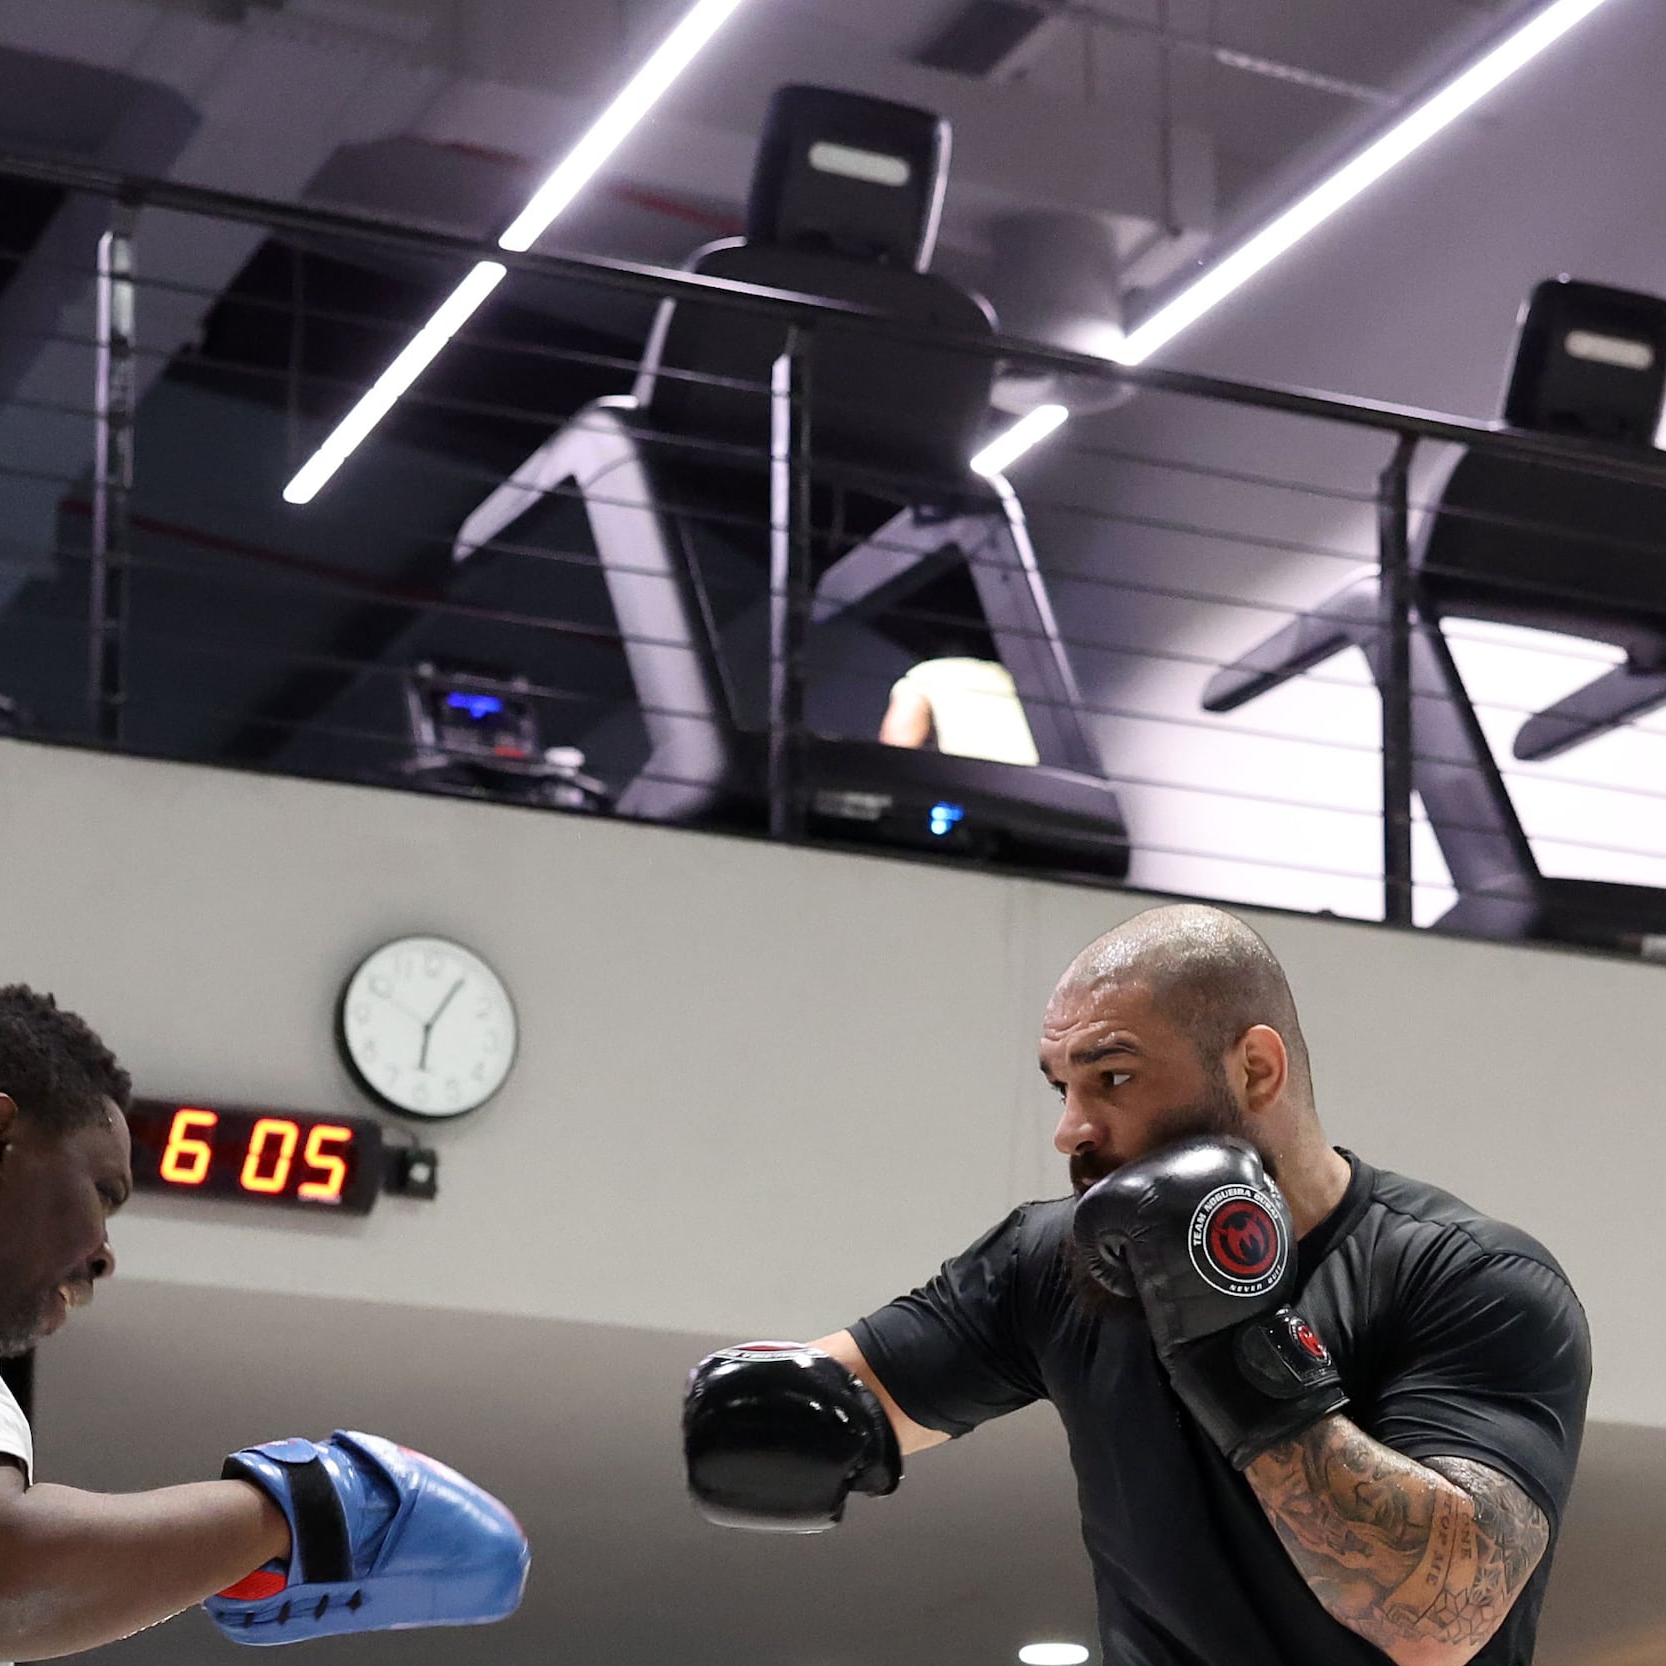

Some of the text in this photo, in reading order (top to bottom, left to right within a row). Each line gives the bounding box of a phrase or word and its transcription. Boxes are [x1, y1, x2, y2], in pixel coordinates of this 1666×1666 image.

[160, 1108, 353, 1198] 6 05
[1193, 1212, 1207, 1247] TEAM
[1203, 1187, 1252, 1213] NOGUEIRA
